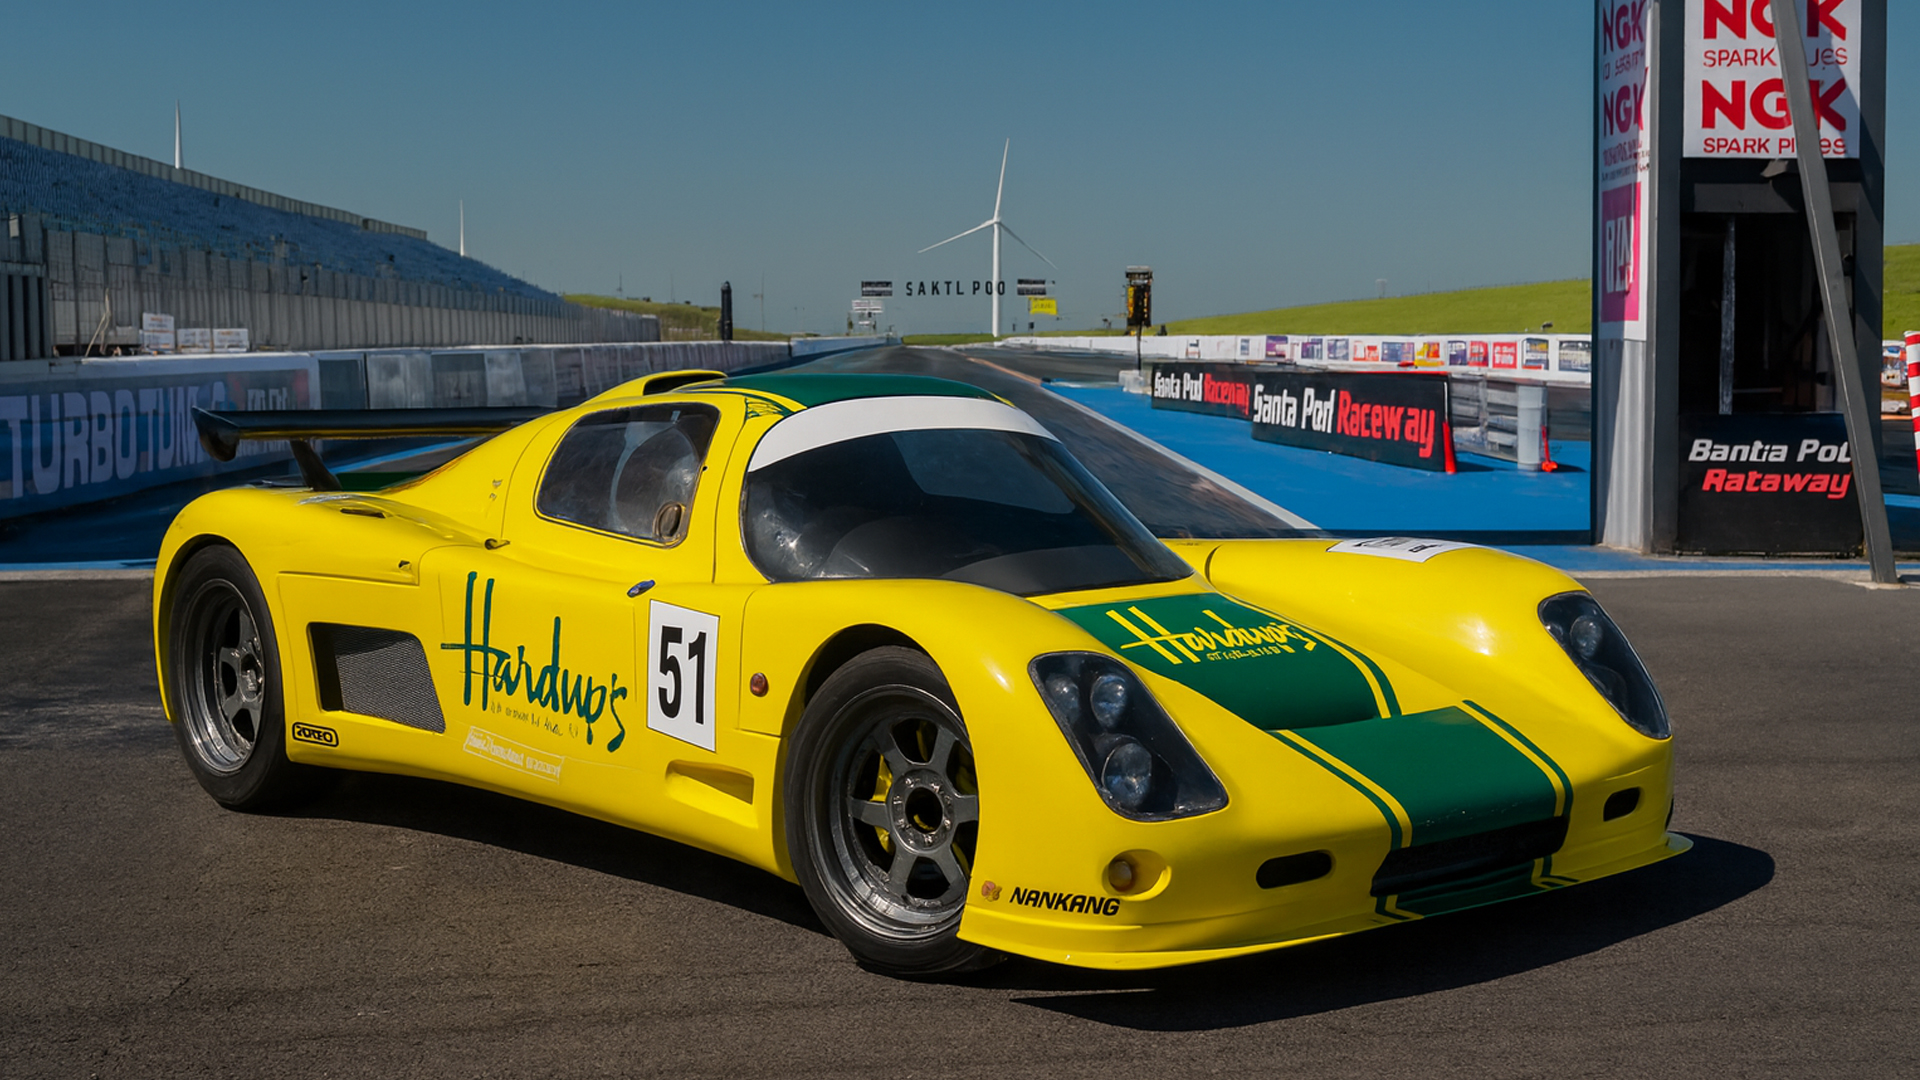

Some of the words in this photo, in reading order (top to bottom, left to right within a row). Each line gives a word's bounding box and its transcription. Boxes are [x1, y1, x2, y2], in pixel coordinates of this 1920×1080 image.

[1603, 0, 1646, 55] NGK
[1703, 48, 1777, 67] SPARK
[1603, 67, 1649, 138] NGK
[1702, 78, 1847, 131] NGK
[1703, 138, 1770, 154] SPARK
[1253, 384, 1297, 428] Santa
[1337, 390, 1435, 458] Raceway
[658, 625, 707, 725] 51
[1009, 887, 1120, 916] NANKANG
